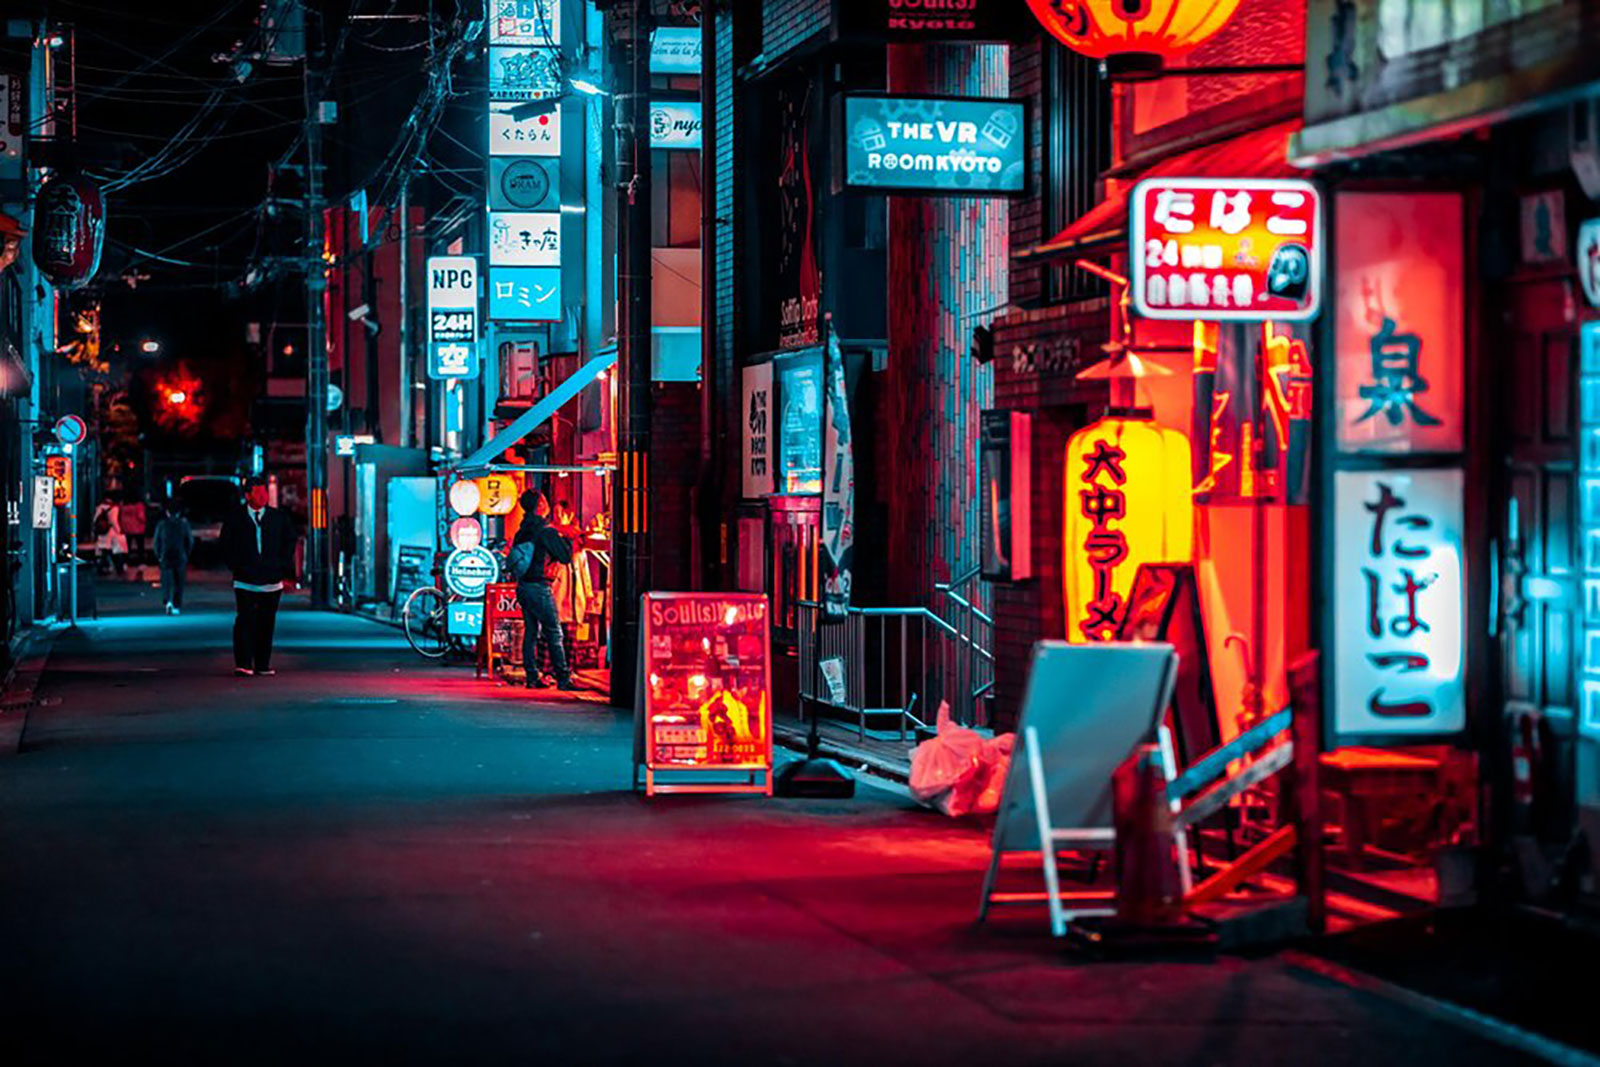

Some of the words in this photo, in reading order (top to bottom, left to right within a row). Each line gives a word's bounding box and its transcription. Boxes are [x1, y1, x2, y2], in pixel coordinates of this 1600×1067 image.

[887, 121, 934, 140] THE
[935, 121, 977, 143] VR
[868, 153, 934, 170] ROOM
[936, 155, 1002, 173] KYOTO
[432, 269, 472, 289] NPC
[495, 282, 557, 307] ロミン
[433, 314, 473, 331] 24H
[1352, 316, 1444, 427] 泉
[451, 566, 493, 577] Heineken
[1362, 481, 1438, 718] たばこ
